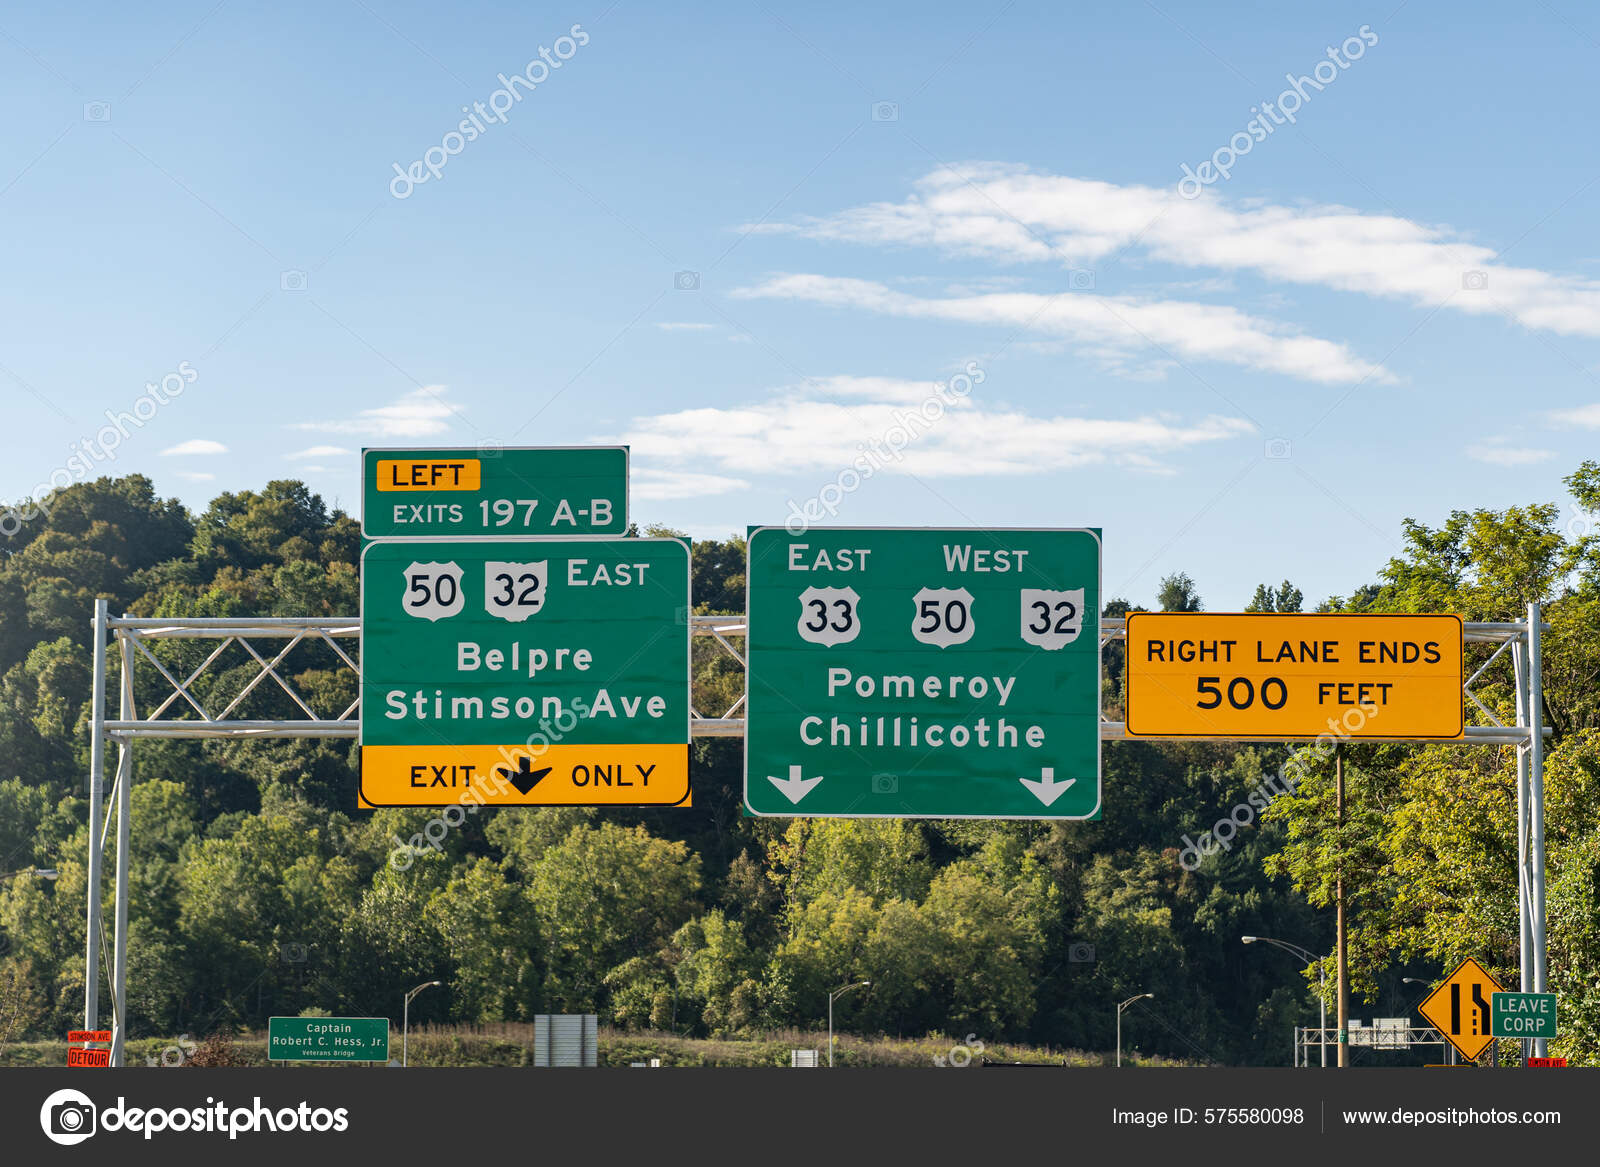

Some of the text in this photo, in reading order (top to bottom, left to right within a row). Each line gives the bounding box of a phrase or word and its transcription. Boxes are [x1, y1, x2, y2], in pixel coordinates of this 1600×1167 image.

[392, 464, 465, 487] LEFT
[393, 498, 613, 527] EXITS 197 A-B
[788, 543, 1029, 573] EAST WEST
[409, 558, 650, 608] 50 32 EAST
[805, 598, 1077, 635] 33 50 32
[457, 641, 593, 679] Belpre
[1147, 639, 1441, 664] RIGHT LANE ENDS
[828, 667, 1017, 707] Pomeroy
[1196, 676, 1393, 710] 500 FEET
[384, 688, 667, 720] Stimson Ave
[799, 715, 1046, 748] Chillicothe
[410, 763, 656, 788] EXIT ONLY
[1499, 998, 1549, 1014] LEAVE
[70, 1032, 110, 1041] STIMSON AVE
[306, 1023, 352, 1034] Captain
[1503, 1017, 1546, 1032] CORP
[272, 1036, 385, 1048] Robert C. Hess, Jr.
[333, 1050, 356, 1058] Bridge
[71, 1051, 107, 1066] DETOUR
